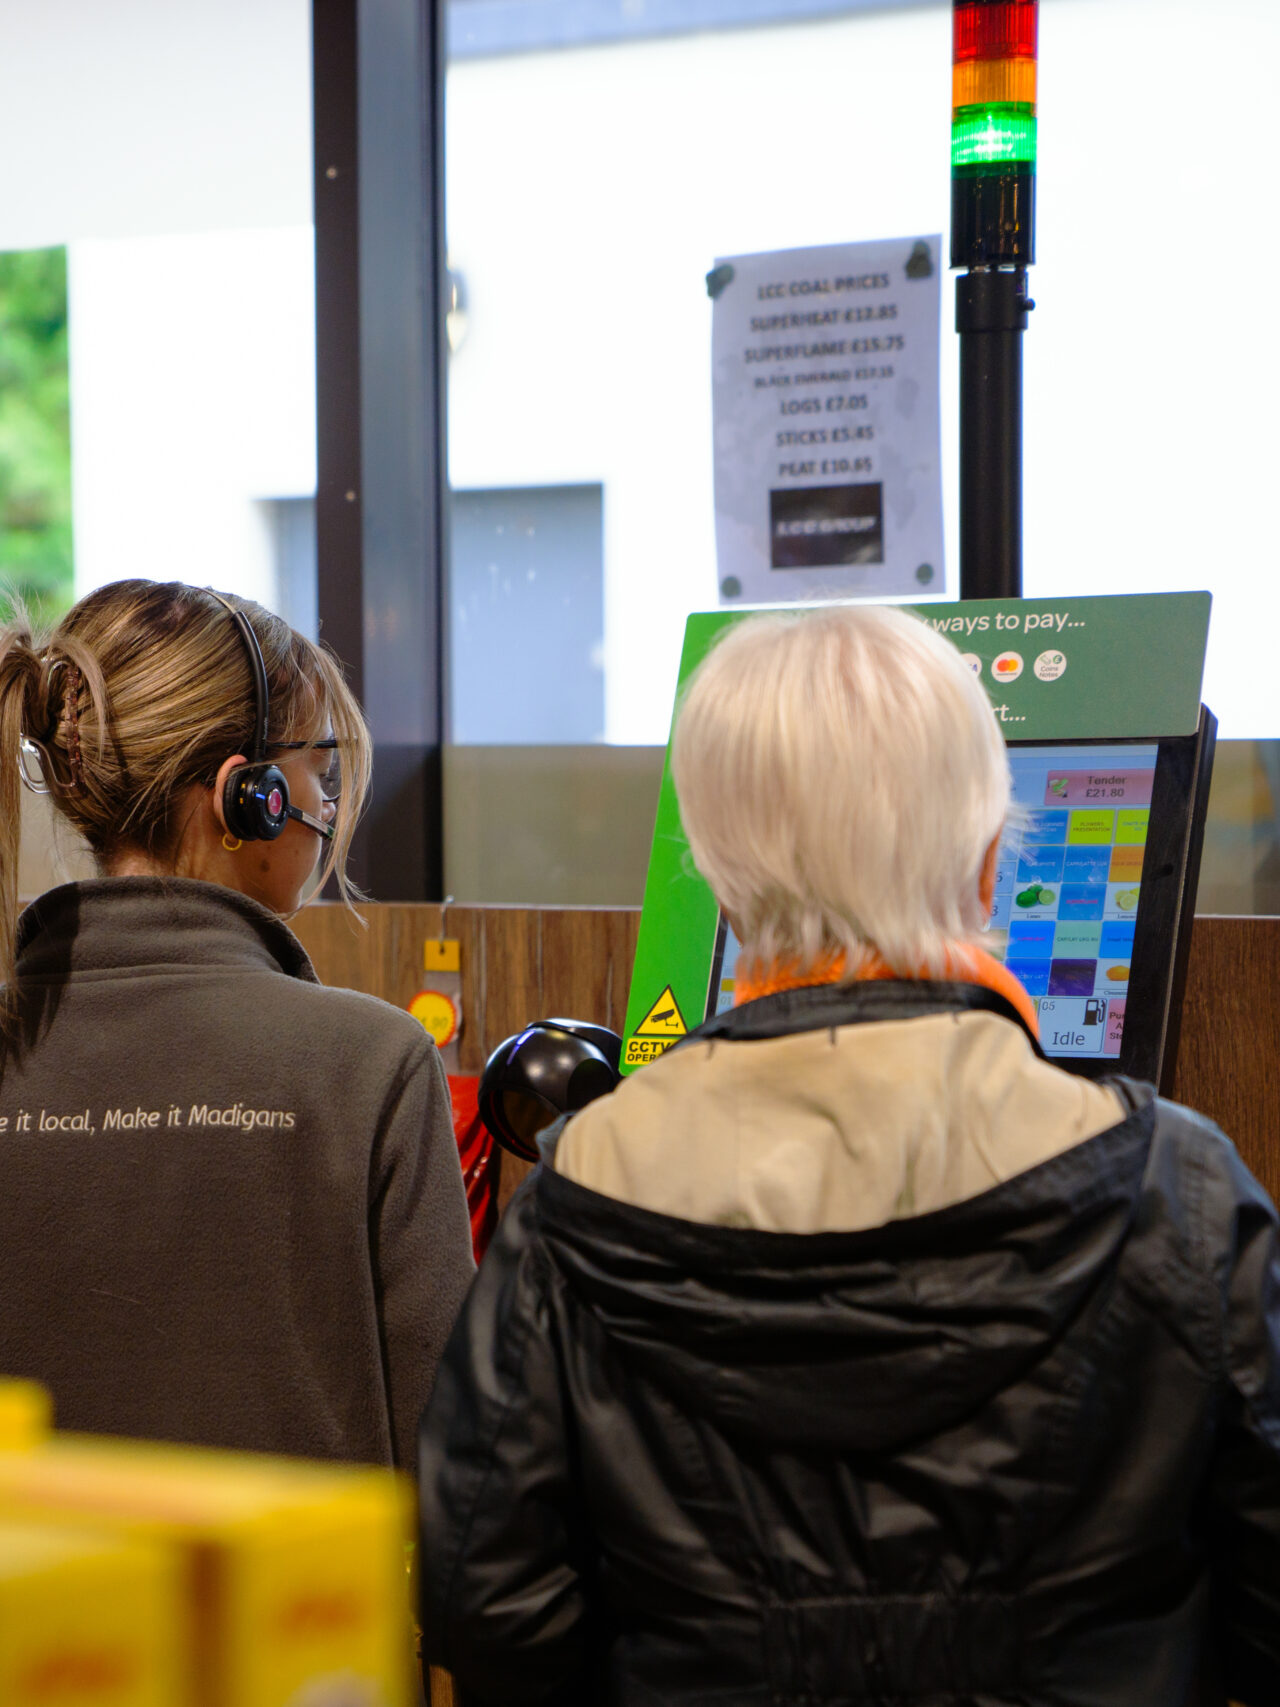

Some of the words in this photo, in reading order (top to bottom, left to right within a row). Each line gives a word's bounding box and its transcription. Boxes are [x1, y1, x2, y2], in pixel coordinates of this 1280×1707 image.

[758, 283, 785, 300] LCC
[789, 279, 830, 296] COAL
[835, 273, 889, 291] PRICES
[750, 309, 839, 332] SUPERHEAT
[745, 340, 846, 363] SUPERFLAME
[780, 398, 821, 415] LOGS
[776, 429, 827, 447] STICKS
[778, 460, 816, 476] PEAT
[933, 614, 990, 636] ways
[995, 612, 1020, 630] to
[1024, 612, 1086, 634] pay...
[1087, 776, 1127, 785] Tender
[1085, 788, 1125, 798] £21.80
[1041, 1002, 1056, 1011] 05
[1052, 1031, 1086, 1046] Idle
[628, 1041, 671, 1053] CCTV
[627, 1054, 657, 1062] OPER
[16, 1109, 32, 1132] it
[38, 1109, 96, 1136] local,
[102, 1107, 161, 1131] Make
[167, 1104, 182, 1127] it
[188, 1102, 296, 1131] Madigans
